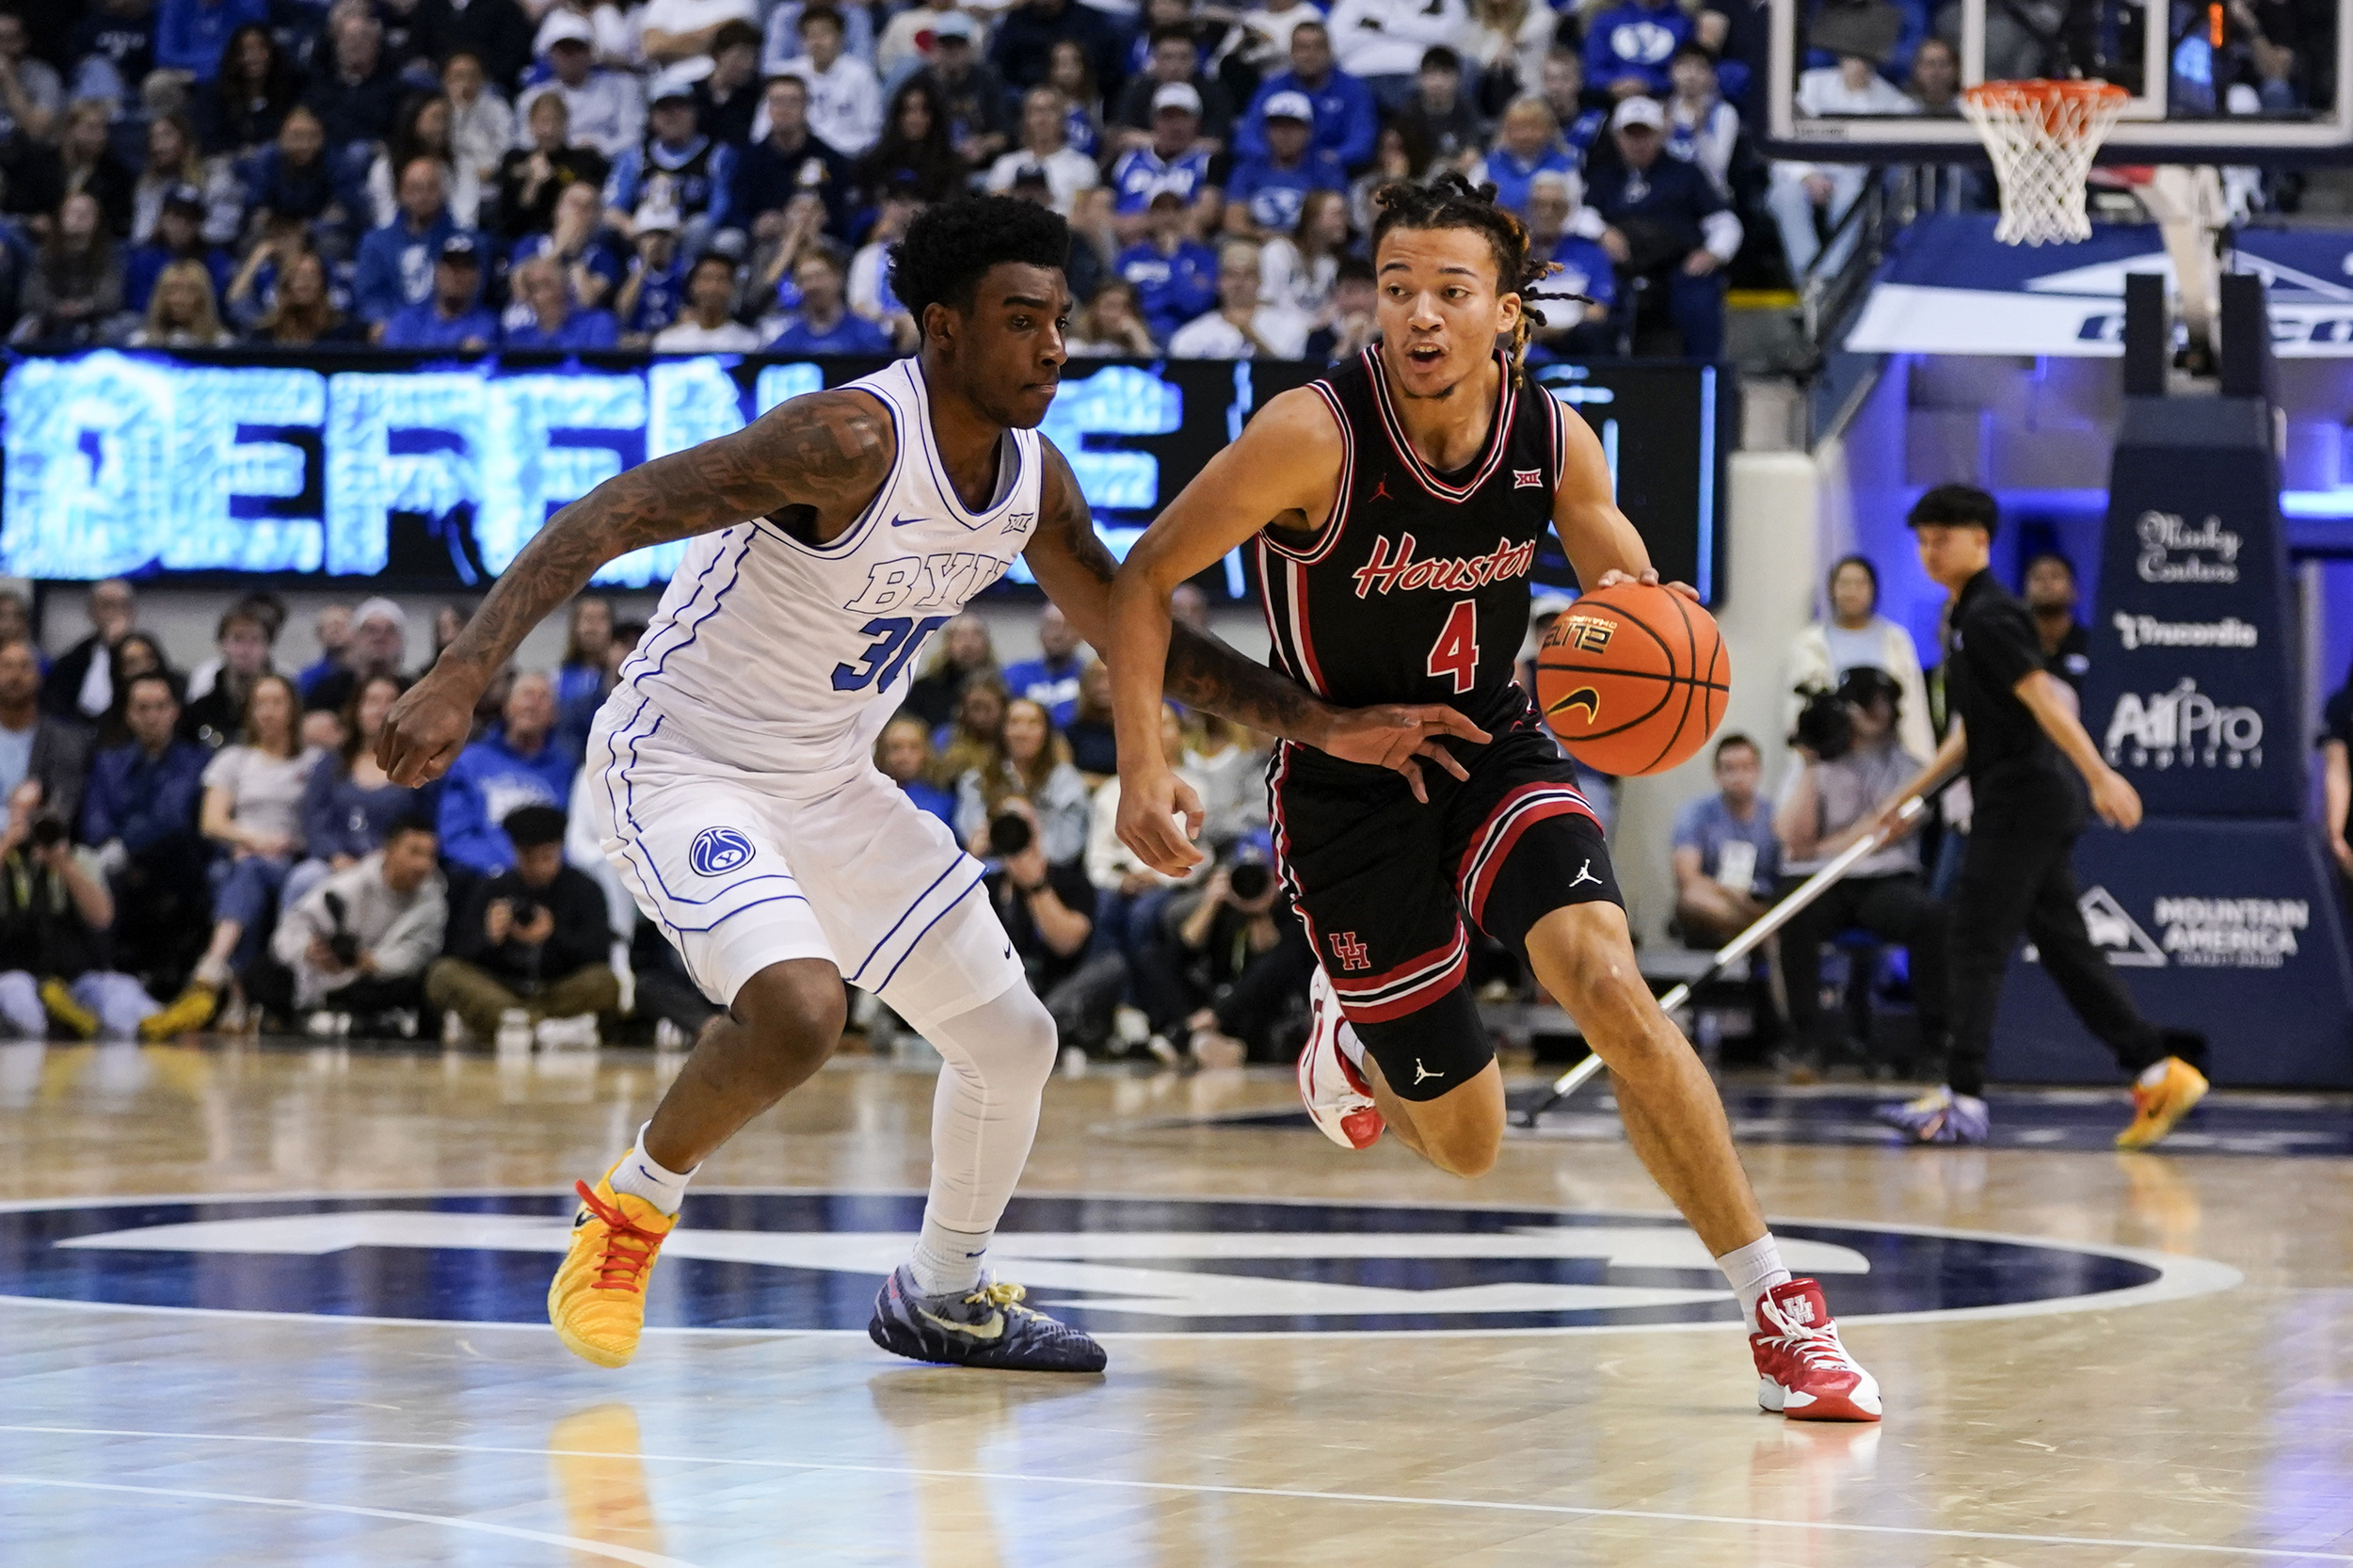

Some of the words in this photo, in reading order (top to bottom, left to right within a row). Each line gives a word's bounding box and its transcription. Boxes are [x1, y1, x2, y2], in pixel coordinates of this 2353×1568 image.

[1352, 532, 1537, 600] Houston
[1427, 599, 1480, 695] 4
[2154, 896, 2310, 930] MOUNTAIN
[2162, 924, 2298, 956] AMERICA
